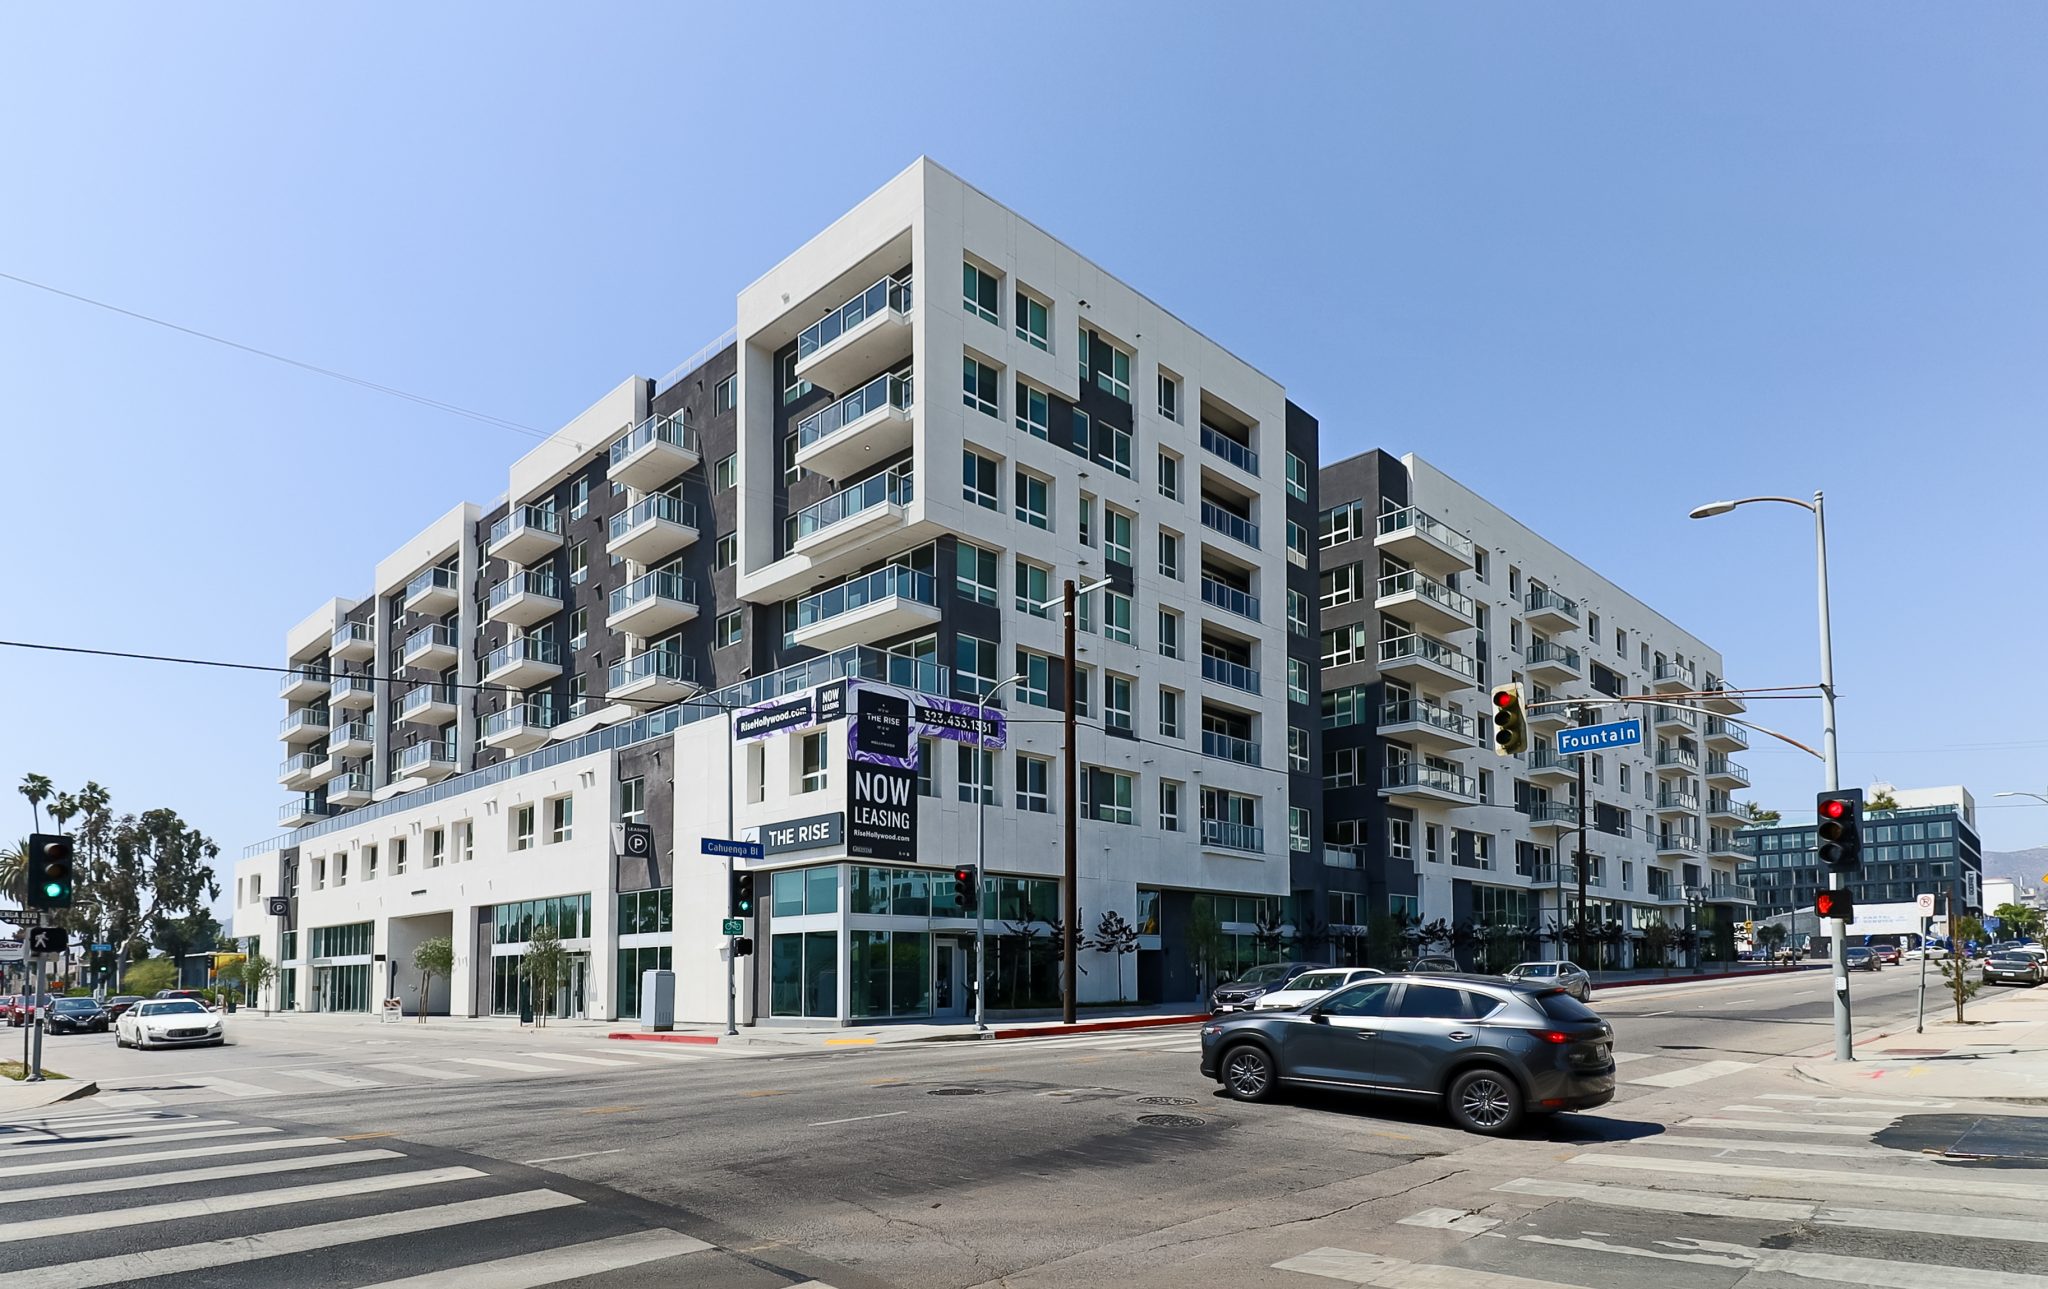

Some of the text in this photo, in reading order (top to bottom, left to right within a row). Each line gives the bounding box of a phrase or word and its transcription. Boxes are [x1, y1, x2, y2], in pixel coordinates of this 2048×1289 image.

[822, 688, 840, 703] NOW
[822, 701, 839, 712] LEASING
[740, 706, 807, 732] RiseHollywood.com
[866, 712, 901, 727] THE RISE
[1562, 727, 1636, 749] Fountain
[855, 770, 911, 807] NOW
[854, 806, 910, 830] LEASING
[768, 822, 830, 847] THE RISE
[853, 829, 910, 842] RiseHollywood.com
[634, 837, 643, 849] P
[707, 842, 748, 857] Cahuenga
